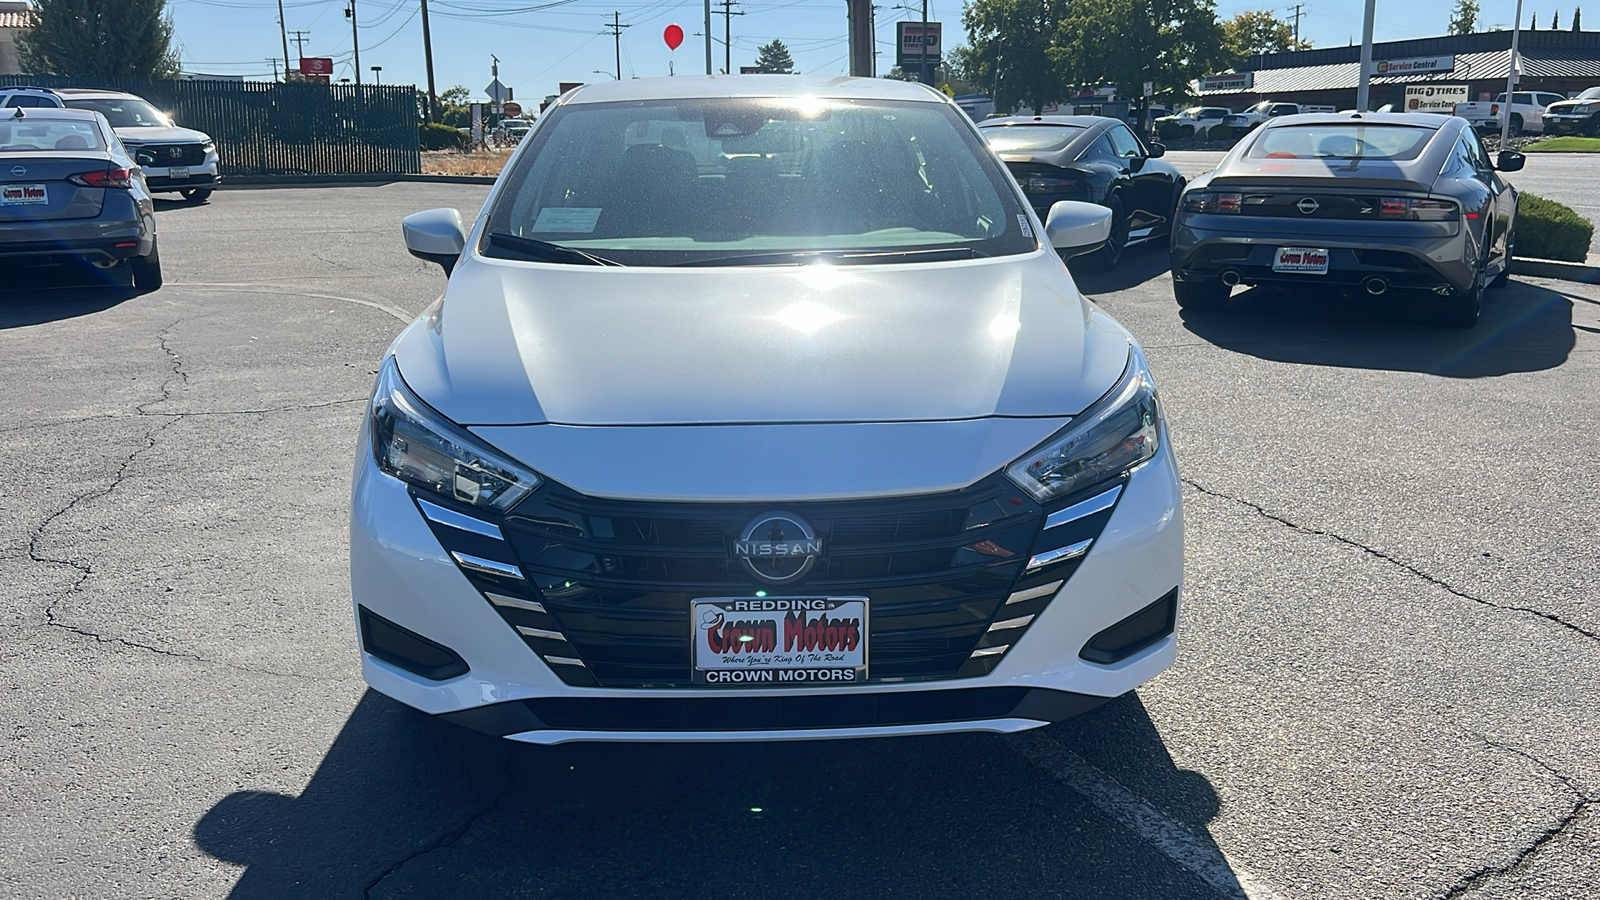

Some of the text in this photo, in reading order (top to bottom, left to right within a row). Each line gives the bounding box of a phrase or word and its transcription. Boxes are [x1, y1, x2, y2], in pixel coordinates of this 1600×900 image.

[1388, 62, 1412, 70] Service
[1414, 60, 1437, 69] Central
[735, 542, 820, 555] NISSAN
[735, 599, 825, 611] REDDING
[707, 610, 860, 654] Crown Motors
[722, 653, 845, 664] Where You're King Of The Road
[706, 669, 855, 682] CROWN MOTORS
